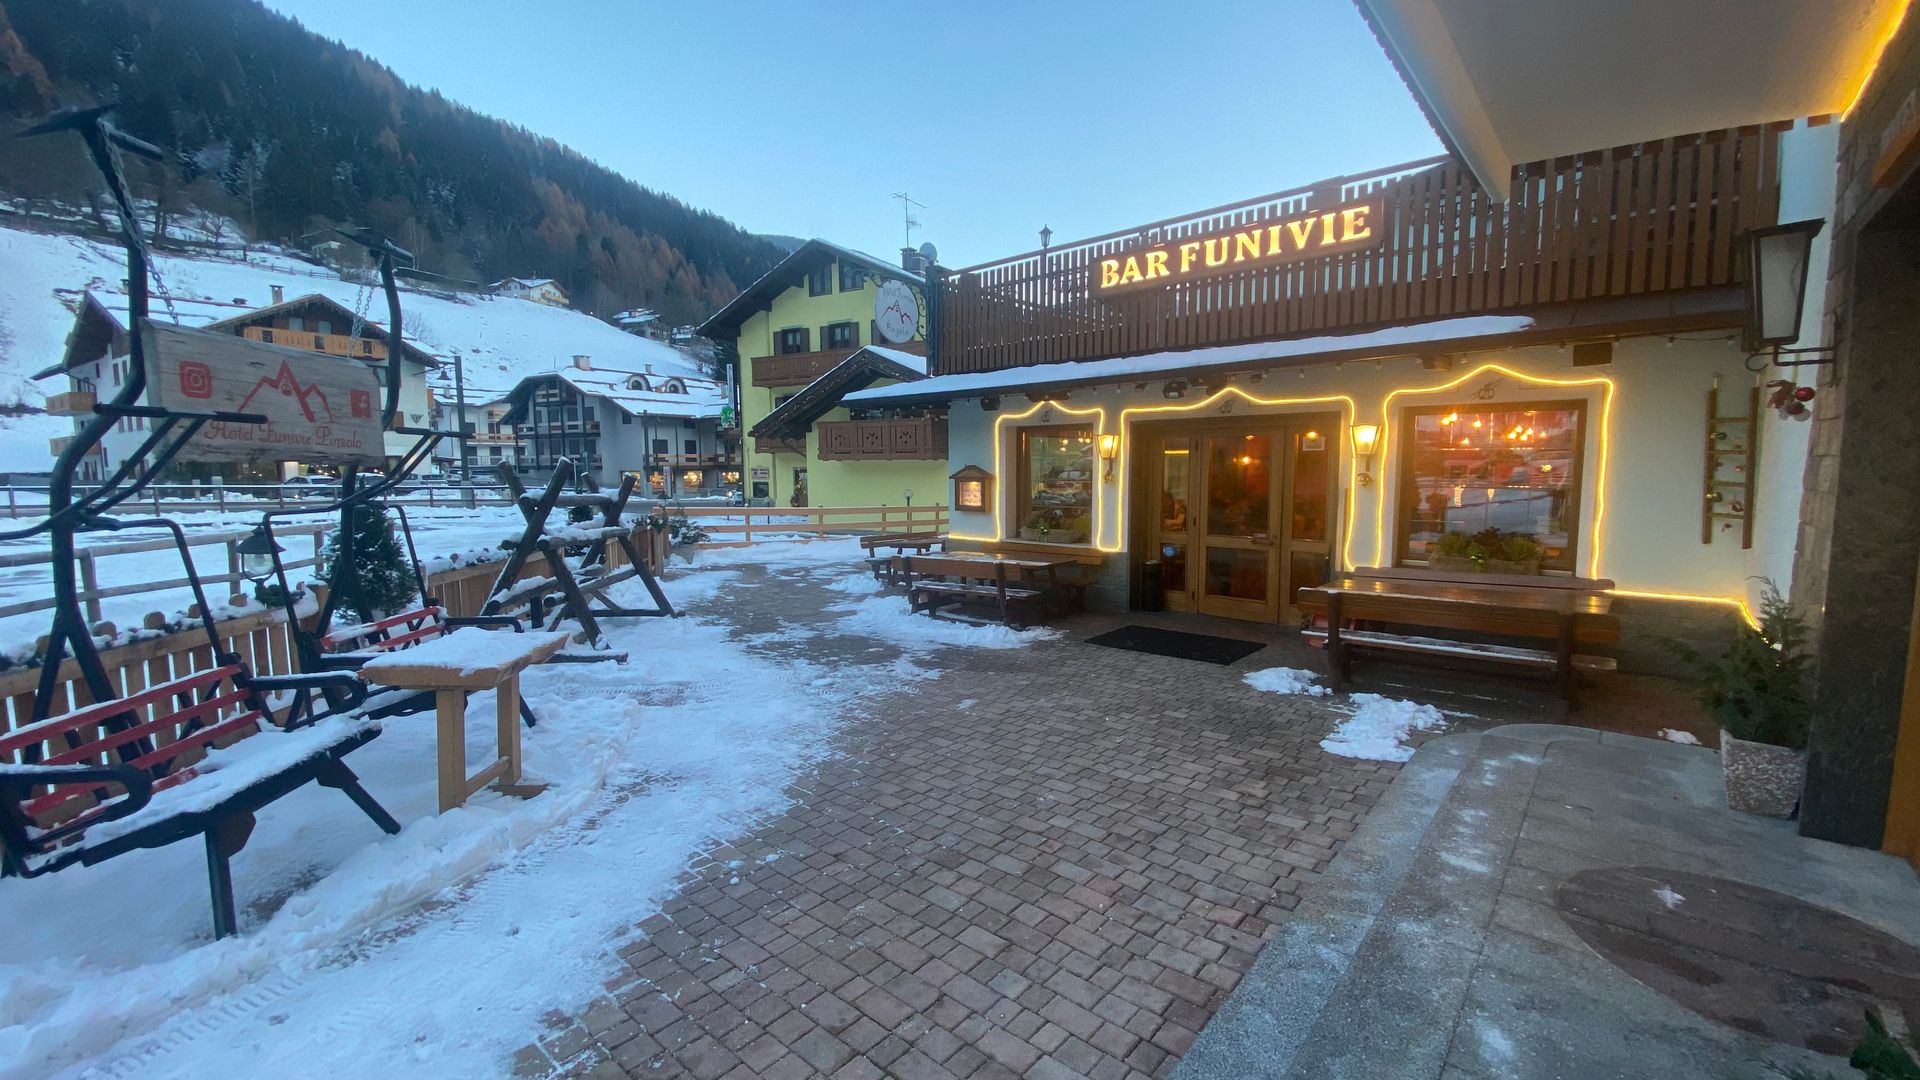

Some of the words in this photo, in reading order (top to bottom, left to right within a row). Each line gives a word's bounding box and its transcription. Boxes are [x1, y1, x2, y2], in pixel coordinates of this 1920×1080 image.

[1100, 249, 1170, 289] BAR
[1179, 205, 1372, 273] FUNIVIE
[204, 420, 254, 442] Hotel
[257, 421, 312, 446] Funivie
[315, 425, 362, 449] Pinzolo
